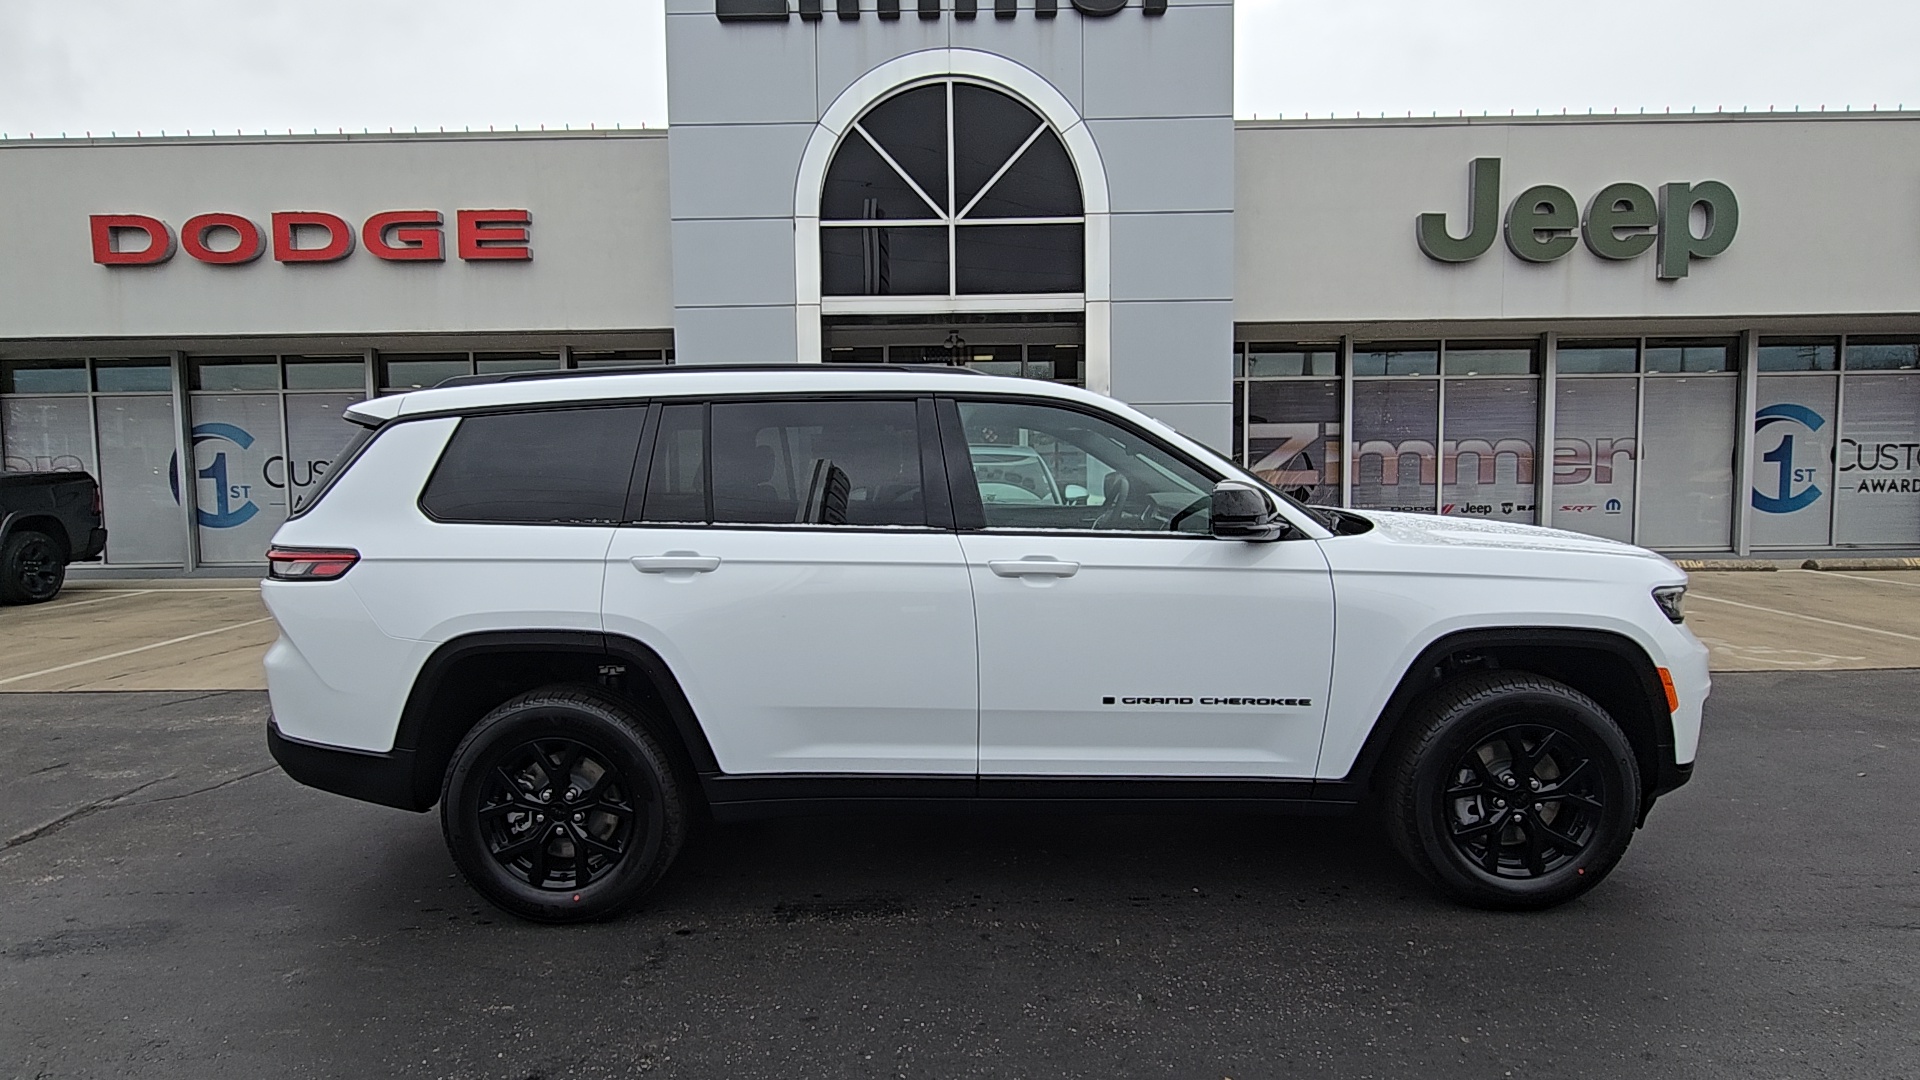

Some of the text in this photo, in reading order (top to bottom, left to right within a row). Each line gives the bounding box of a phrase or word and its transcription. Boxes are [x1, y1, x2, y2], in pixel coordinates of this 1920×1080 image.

[1416, 157, 1739, 279] Jeep
[89, 208, 532, 265] DODGE
[1248, 422, 1644, 486] Zimmer
[1831, 438, 1920, 471] CUST
[263, 456, 333, 488] CUS
[1461, 502, 1492, 515] Jeep
[1559, 505, 1597, 513] SRT
[1121, 697, 1312, 707] GRAND CHEROKEE
